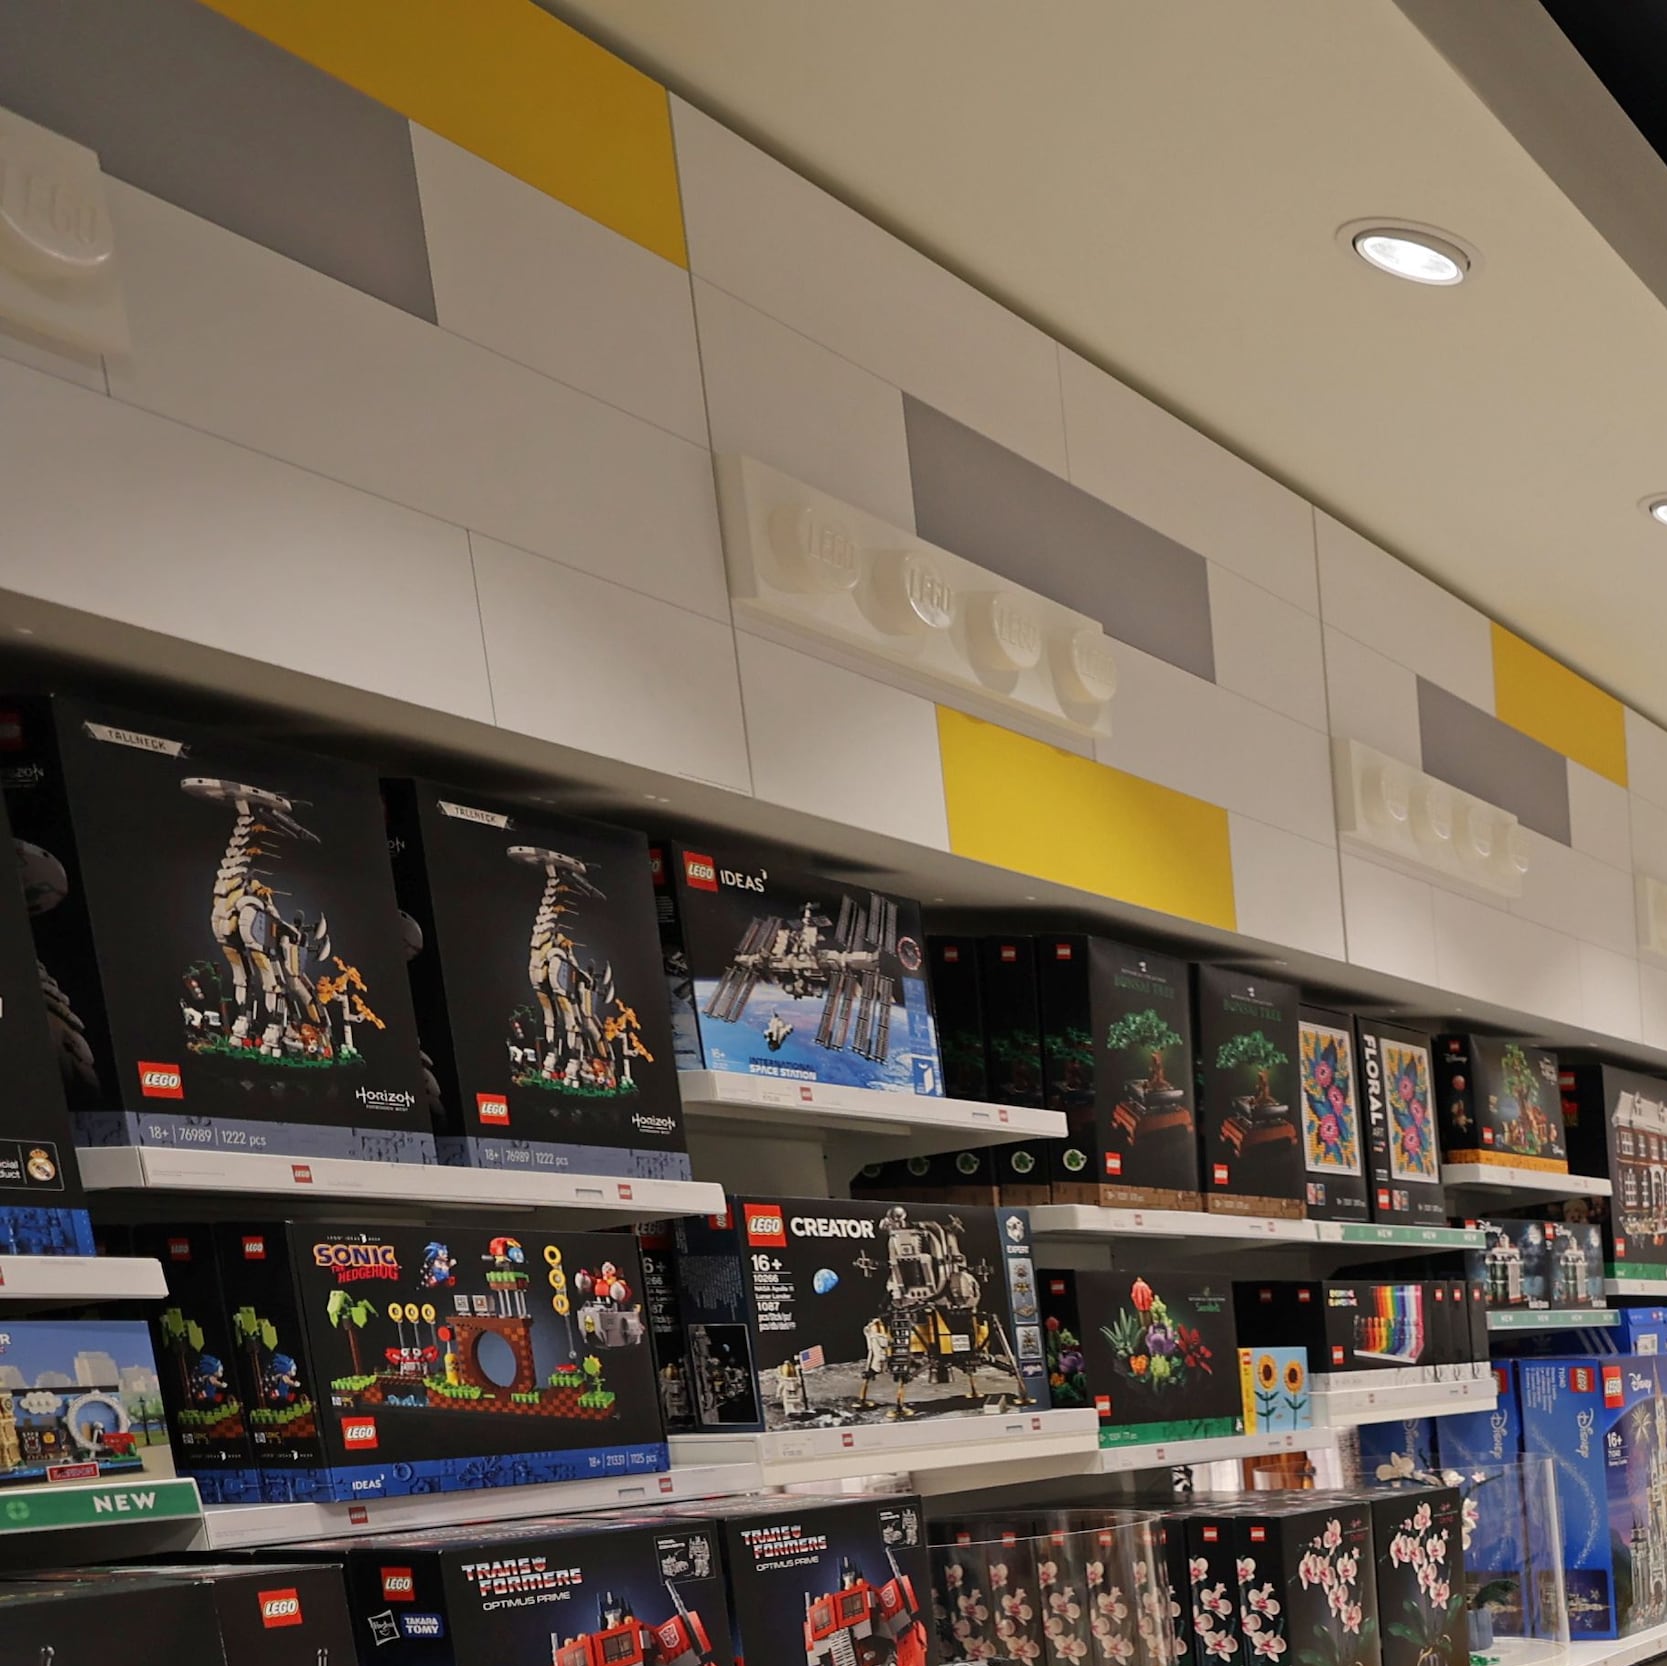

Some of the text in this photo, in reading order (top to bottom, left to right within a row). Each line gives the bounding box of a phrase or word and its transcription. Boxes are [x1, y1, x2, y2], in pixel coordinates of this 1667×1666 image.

[107, 728, 168, 753] TALLNECK
[720, 869, 766, 893] IDEAS
[143, 1072, 182, 1090] LEGO
[749, 1064, 817, 1081] SPACE STATION
[1362, 1033, 1386, 1126] FLORAL
[480, 1103, 507, 1116] LEGO
[148, 1126, 267, 1147] 18+ 76989 1222 pcs
[484, 1147, 555, 1165] 18+ 76989 1222
[750, 1216, 876, 1239] LEGO CREATOR
[313, 1244, 398, 1267] SONIC
[751, 1254, 783, 1272] 16+
[337, 1264, 402, 1284] HEDGEHOG
[753, 1273, 779, 1284] 10266
[757, 1301, 780, 1312] 1087
[345, 1426, 376, 1440] LEGO
[351, 1479, 382, 1491] IDEAS
[93, 1492, 157, 1514] NEW
[756, 1555, 820, 1572] OPTIMUS PRIME
[384, 1576, 413, 1591] LEGO
[478, 1567, 584, 1597] FORMERS
[263, 1599, 299, 1617] LEGO
[482, 1590, 571, 1612] OPTIMUS PRIME
[404, 1616, 440, 1626] TAKARA
[405, 1624, 440, 1635] TOMY
